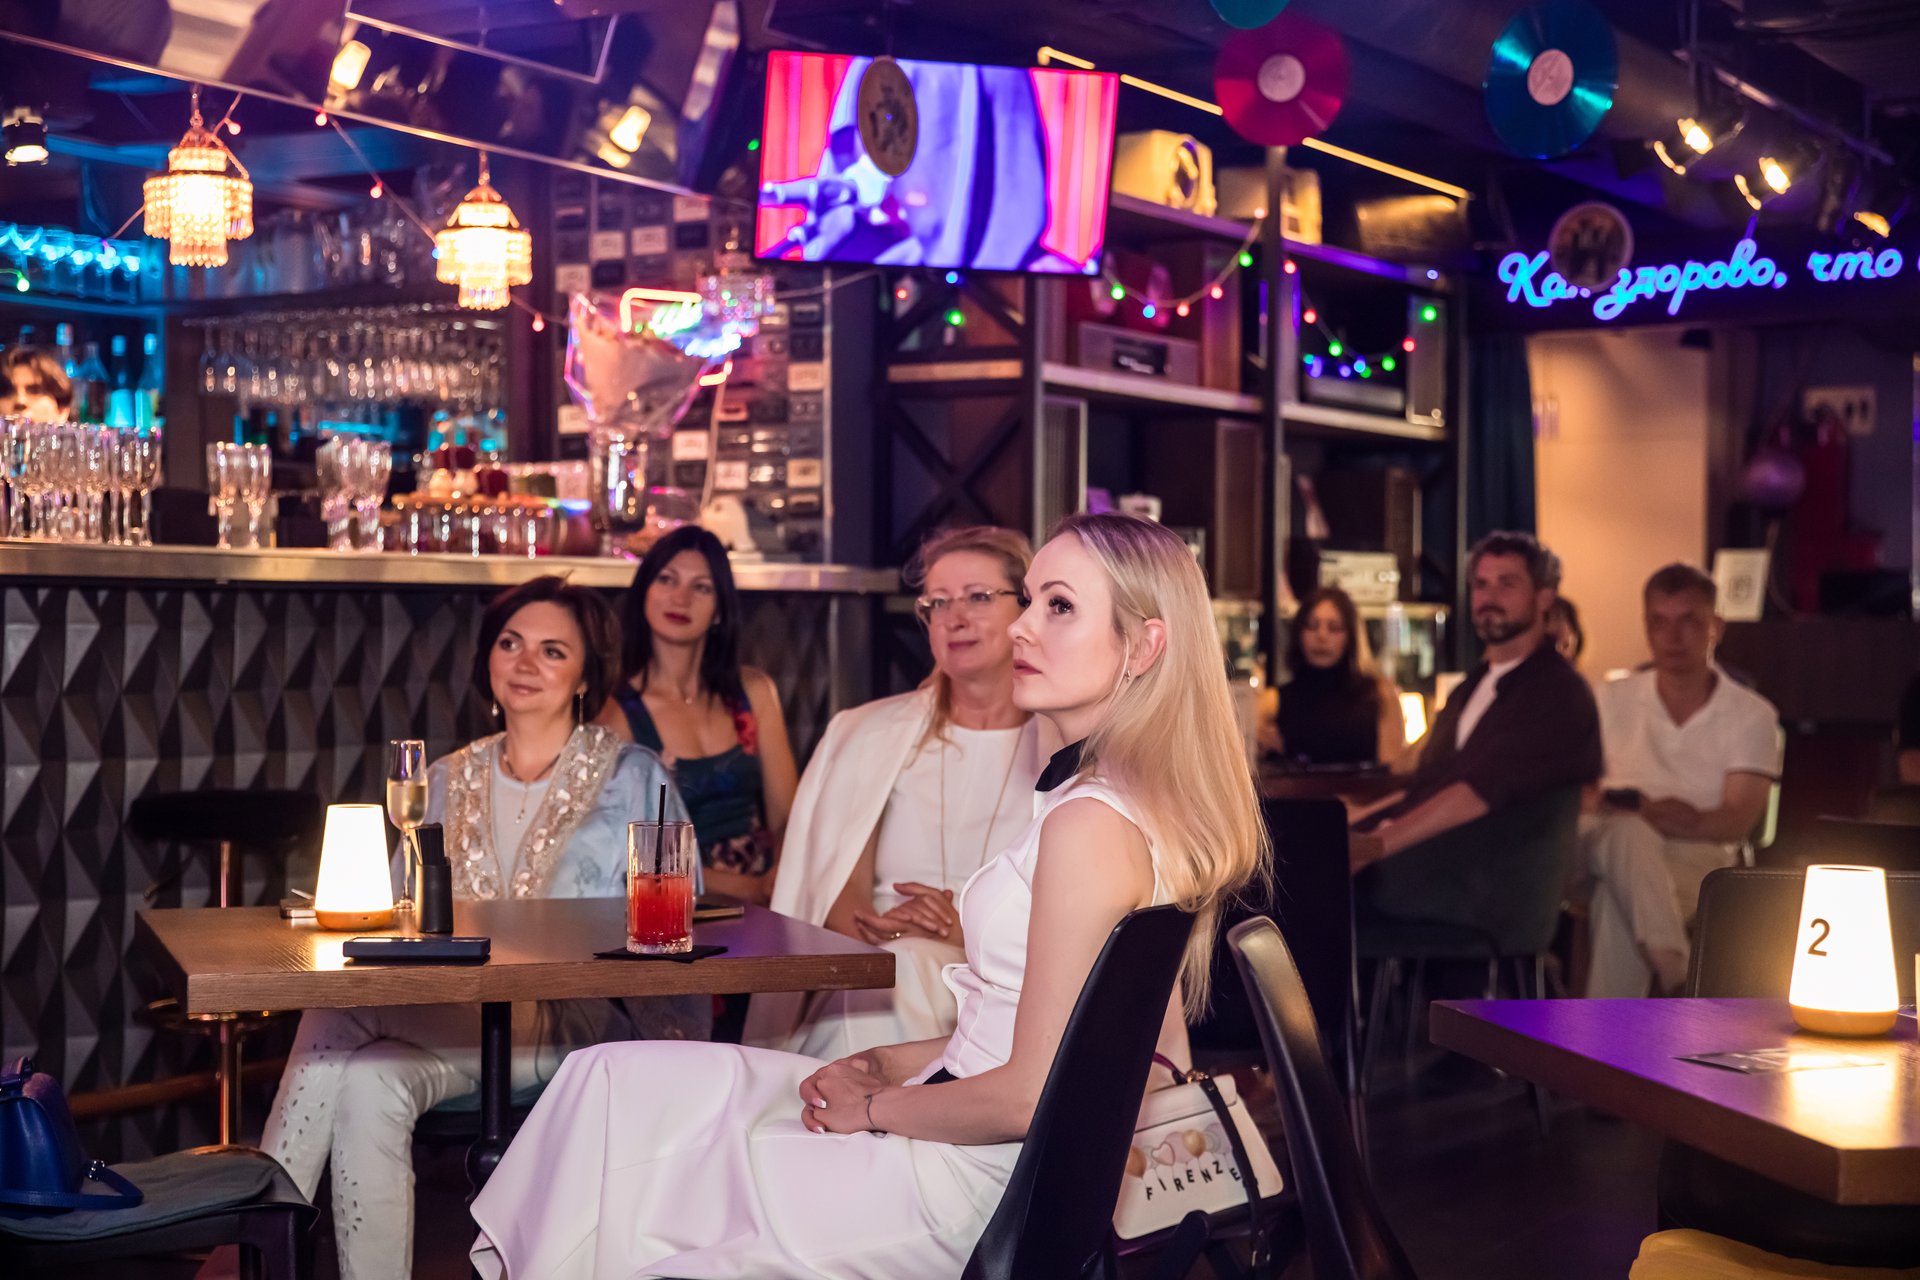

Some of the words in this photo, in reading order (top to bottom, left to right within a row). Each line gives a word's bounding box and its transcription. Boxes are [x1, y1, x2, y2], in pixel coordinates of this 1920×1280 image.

[1498, 250, 1592, 308] Ка
[1593, 238, 1788, 321] здорово,
[1806, 248, 1904, 282] что
[1807, 918, 1830, 957] 2
[1145, 1160, 1242, 1201] FIRENZE
